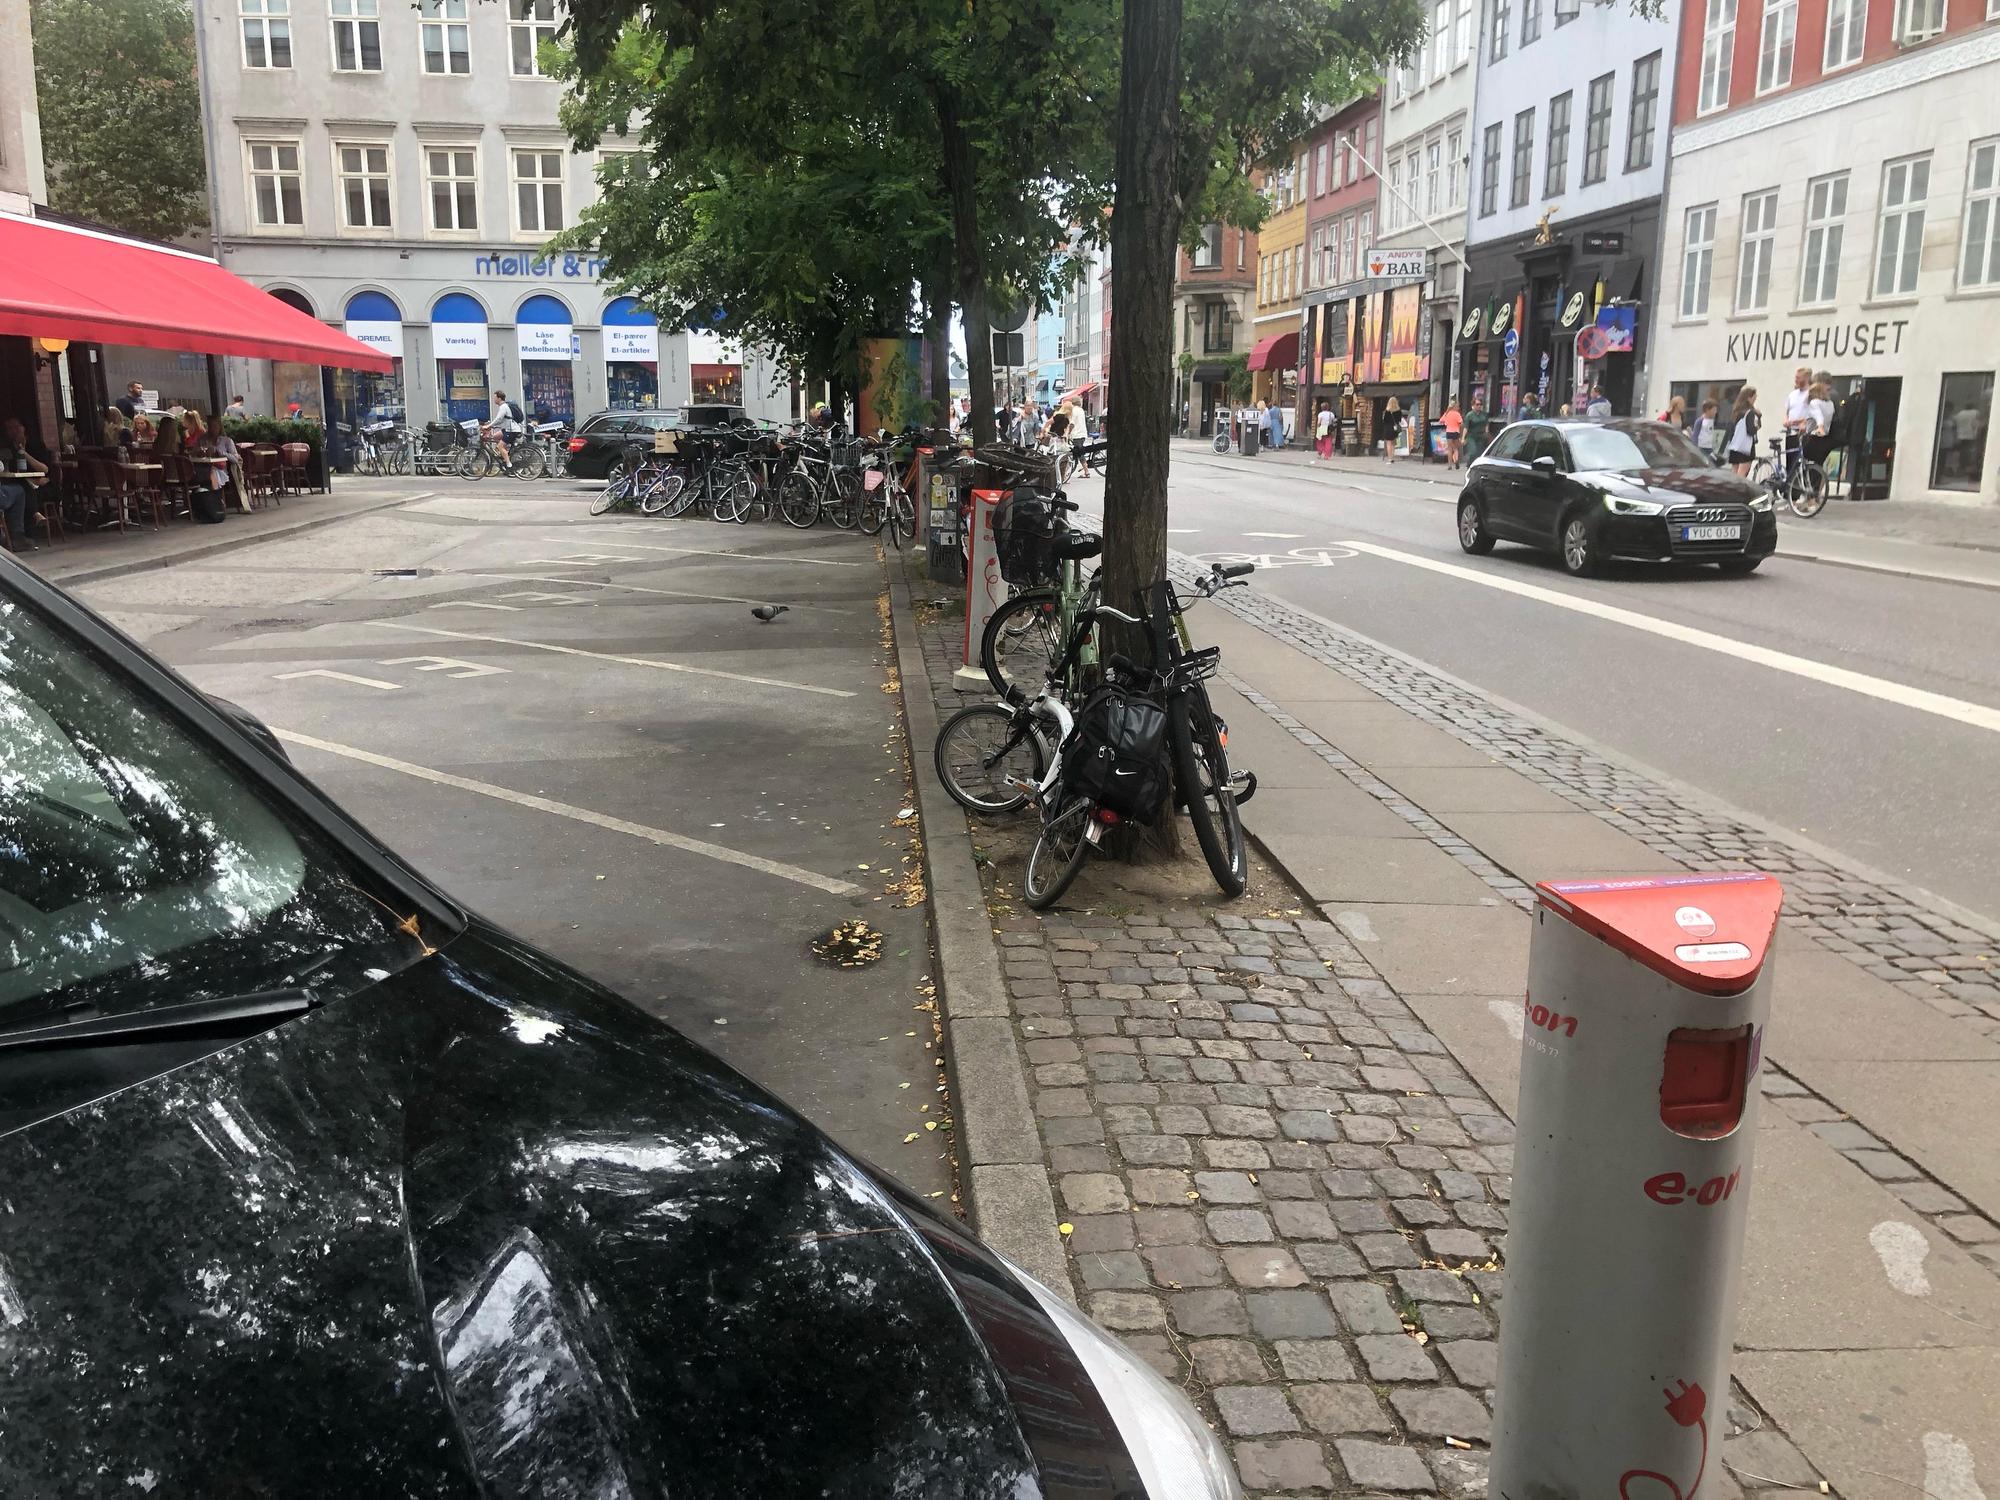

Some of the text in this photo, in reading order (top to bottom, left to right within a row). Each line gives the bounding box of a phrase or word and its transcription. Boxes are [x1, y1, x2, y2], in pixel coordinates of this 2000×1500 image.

[476, 253, 555, 277] møller
[563, 254, 581, 277] &
[1387, 262, 1422, 276] BAR
[535, 331, 554, 339] Låse
[445, 337, 477, 346] Værktøj
[1726, 320, 1909, 363] KVINDEHUSET
[1693, 527, 1736, 538] YUC 030
